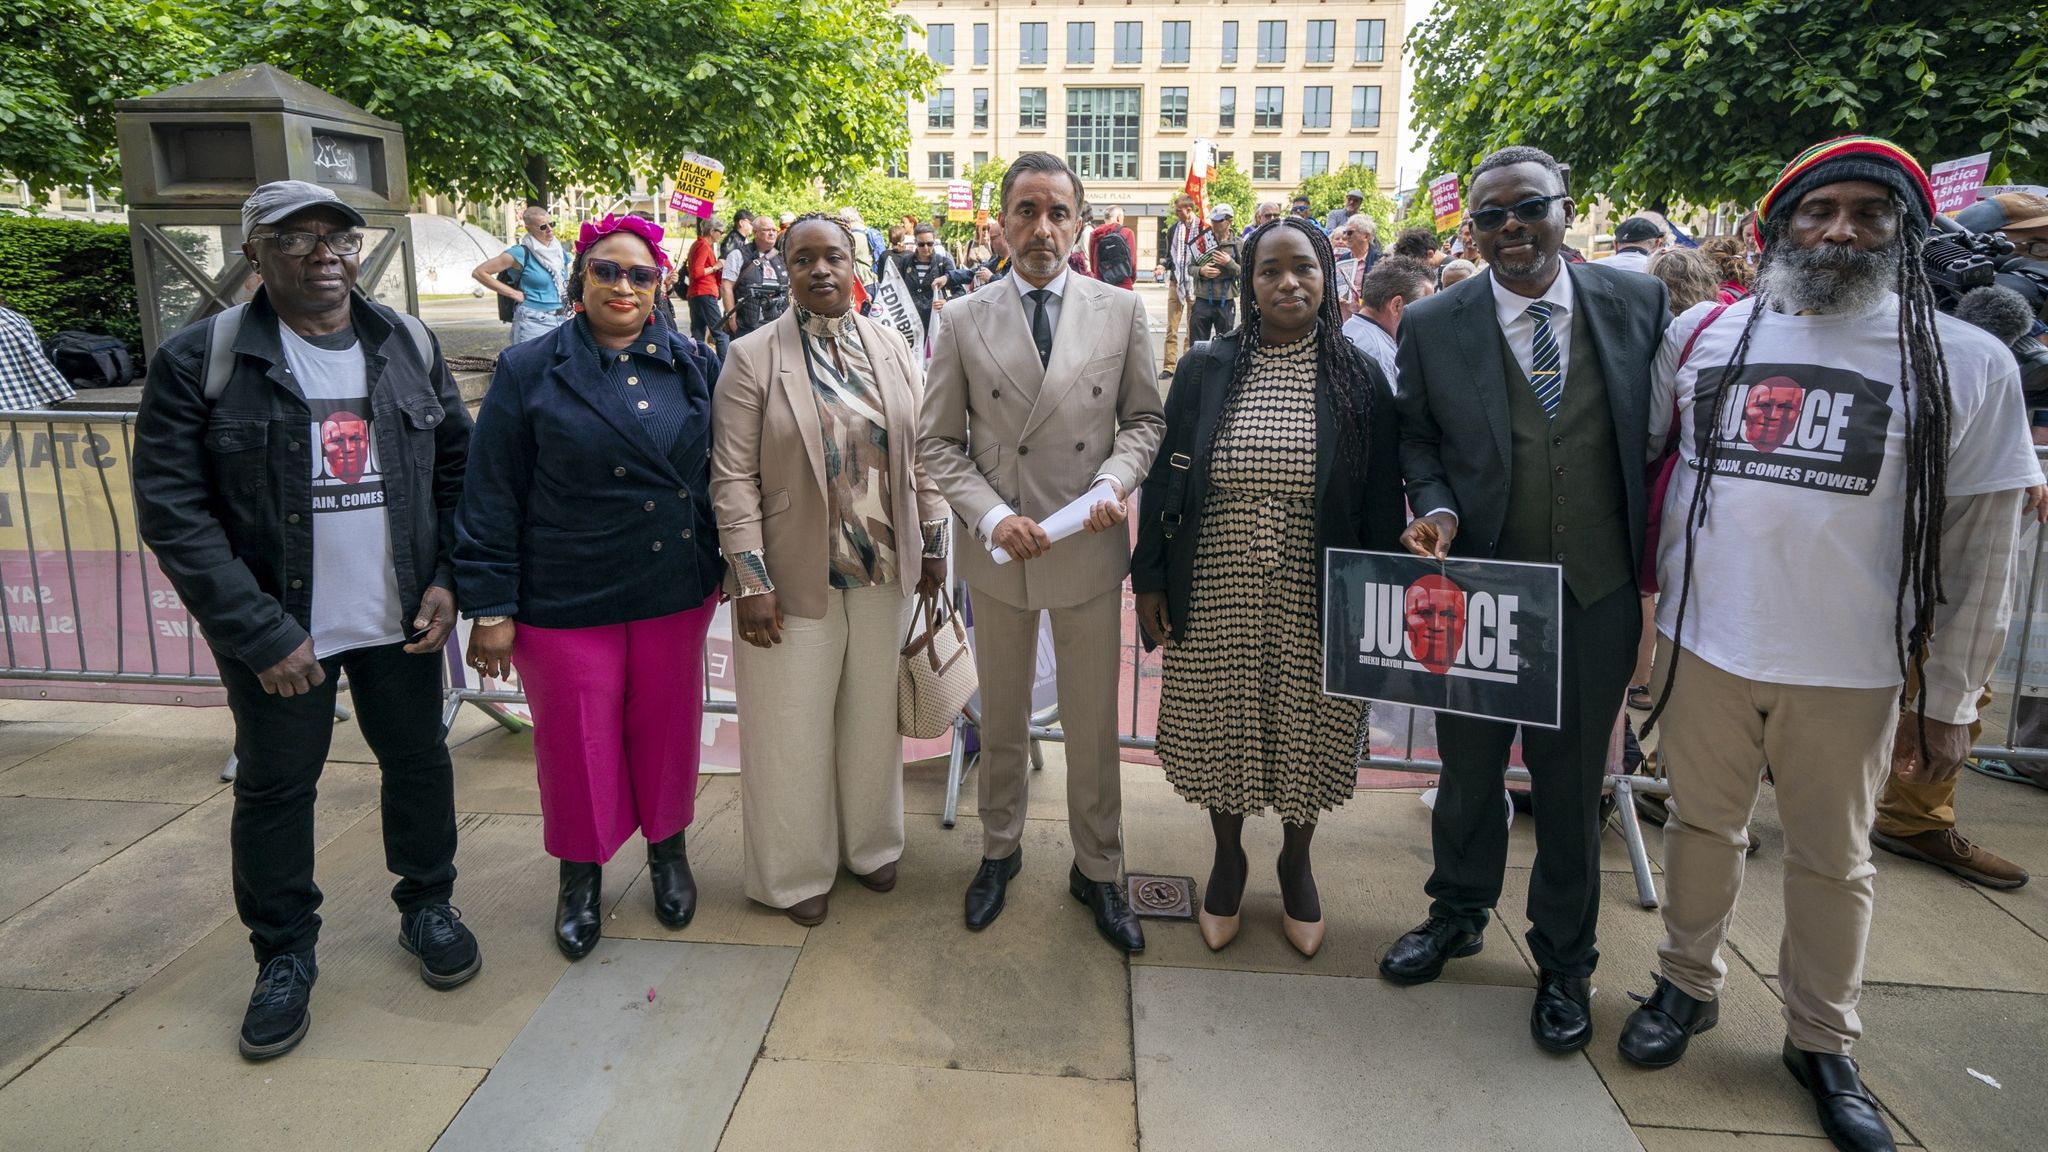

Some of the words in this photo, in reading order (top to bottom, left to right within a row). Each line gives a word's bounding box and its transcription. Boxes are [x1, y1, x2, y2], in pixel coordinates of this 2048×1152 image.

[680, 172, 706, 187] LIVES
[682, 162, 713, 179] BLACK
[1931, 168, 1978, 187] Justice
[676, 180, 715, 201] MATTER
[1936, 195, 1963, 212] ayoh
[1744, 461, 1801, 482] COMES
[312, 496, 339, 509] AIN,
[341, 491, 385, 508] COMES
[1359, 582, 1519, 671] JUSTICE
[1359, 654, 1380, 666] SHEKU
[1380, 657, 1402, 669] BAYOH
